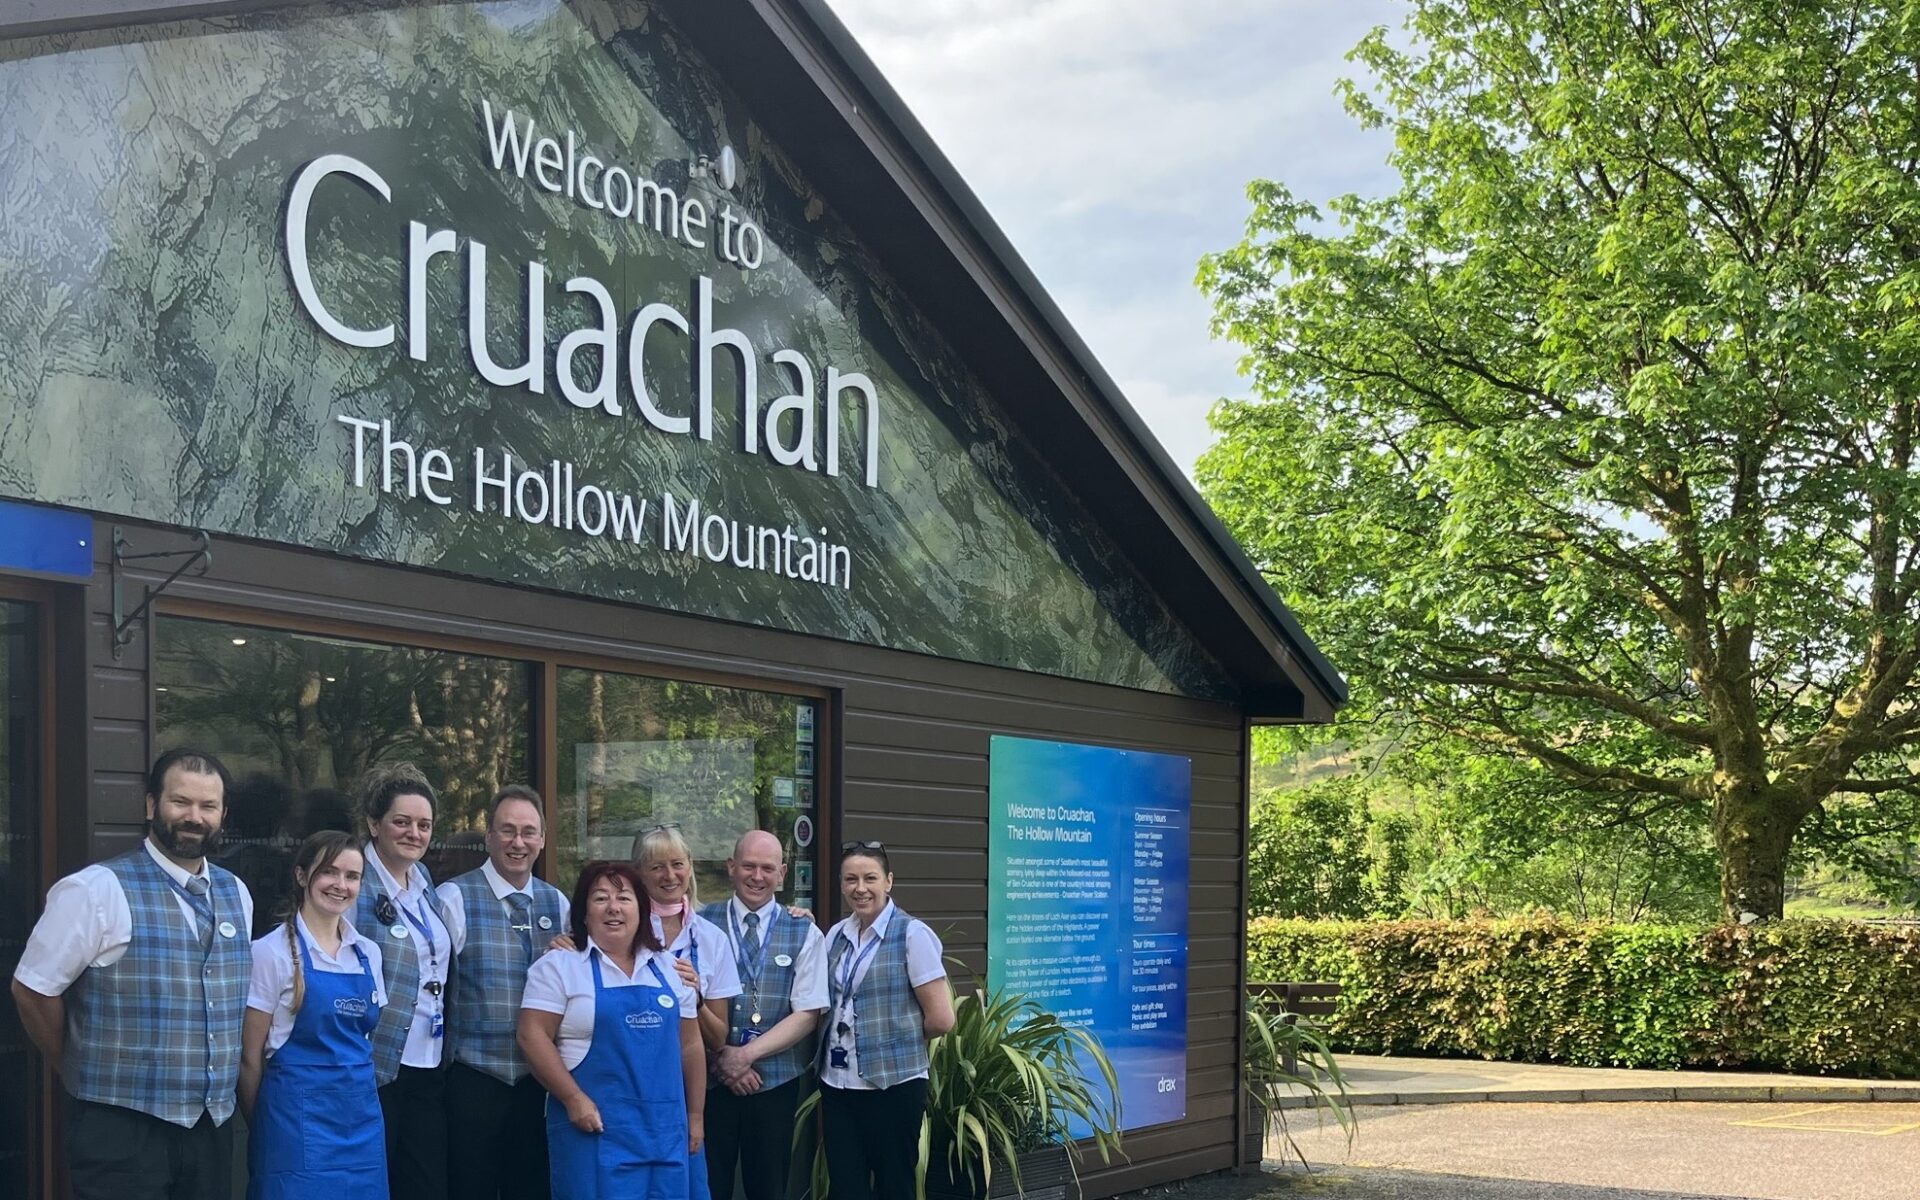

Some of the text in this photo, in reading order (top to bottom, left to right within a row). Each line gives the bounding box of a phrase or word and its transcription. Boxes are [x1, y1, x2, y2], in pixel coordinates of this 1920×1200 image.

[482, 100, 765, 270] Welcome to
[286, 154, 879, 489] Cruachan
[338, 415, 852, 590] The Hollow Mountain
[1008, 803, 1096, 824] Welcome to Cruachan,
[1134, 812, 1167, 824] Opening hours
[1007, 825, 1092, 842] The Hollow Mountain
[1133, 940, 1156, 949] Tour times
[625, 1011, 663, 1024] Cruachan
[1158, 1076, 1176, 1093] drax
